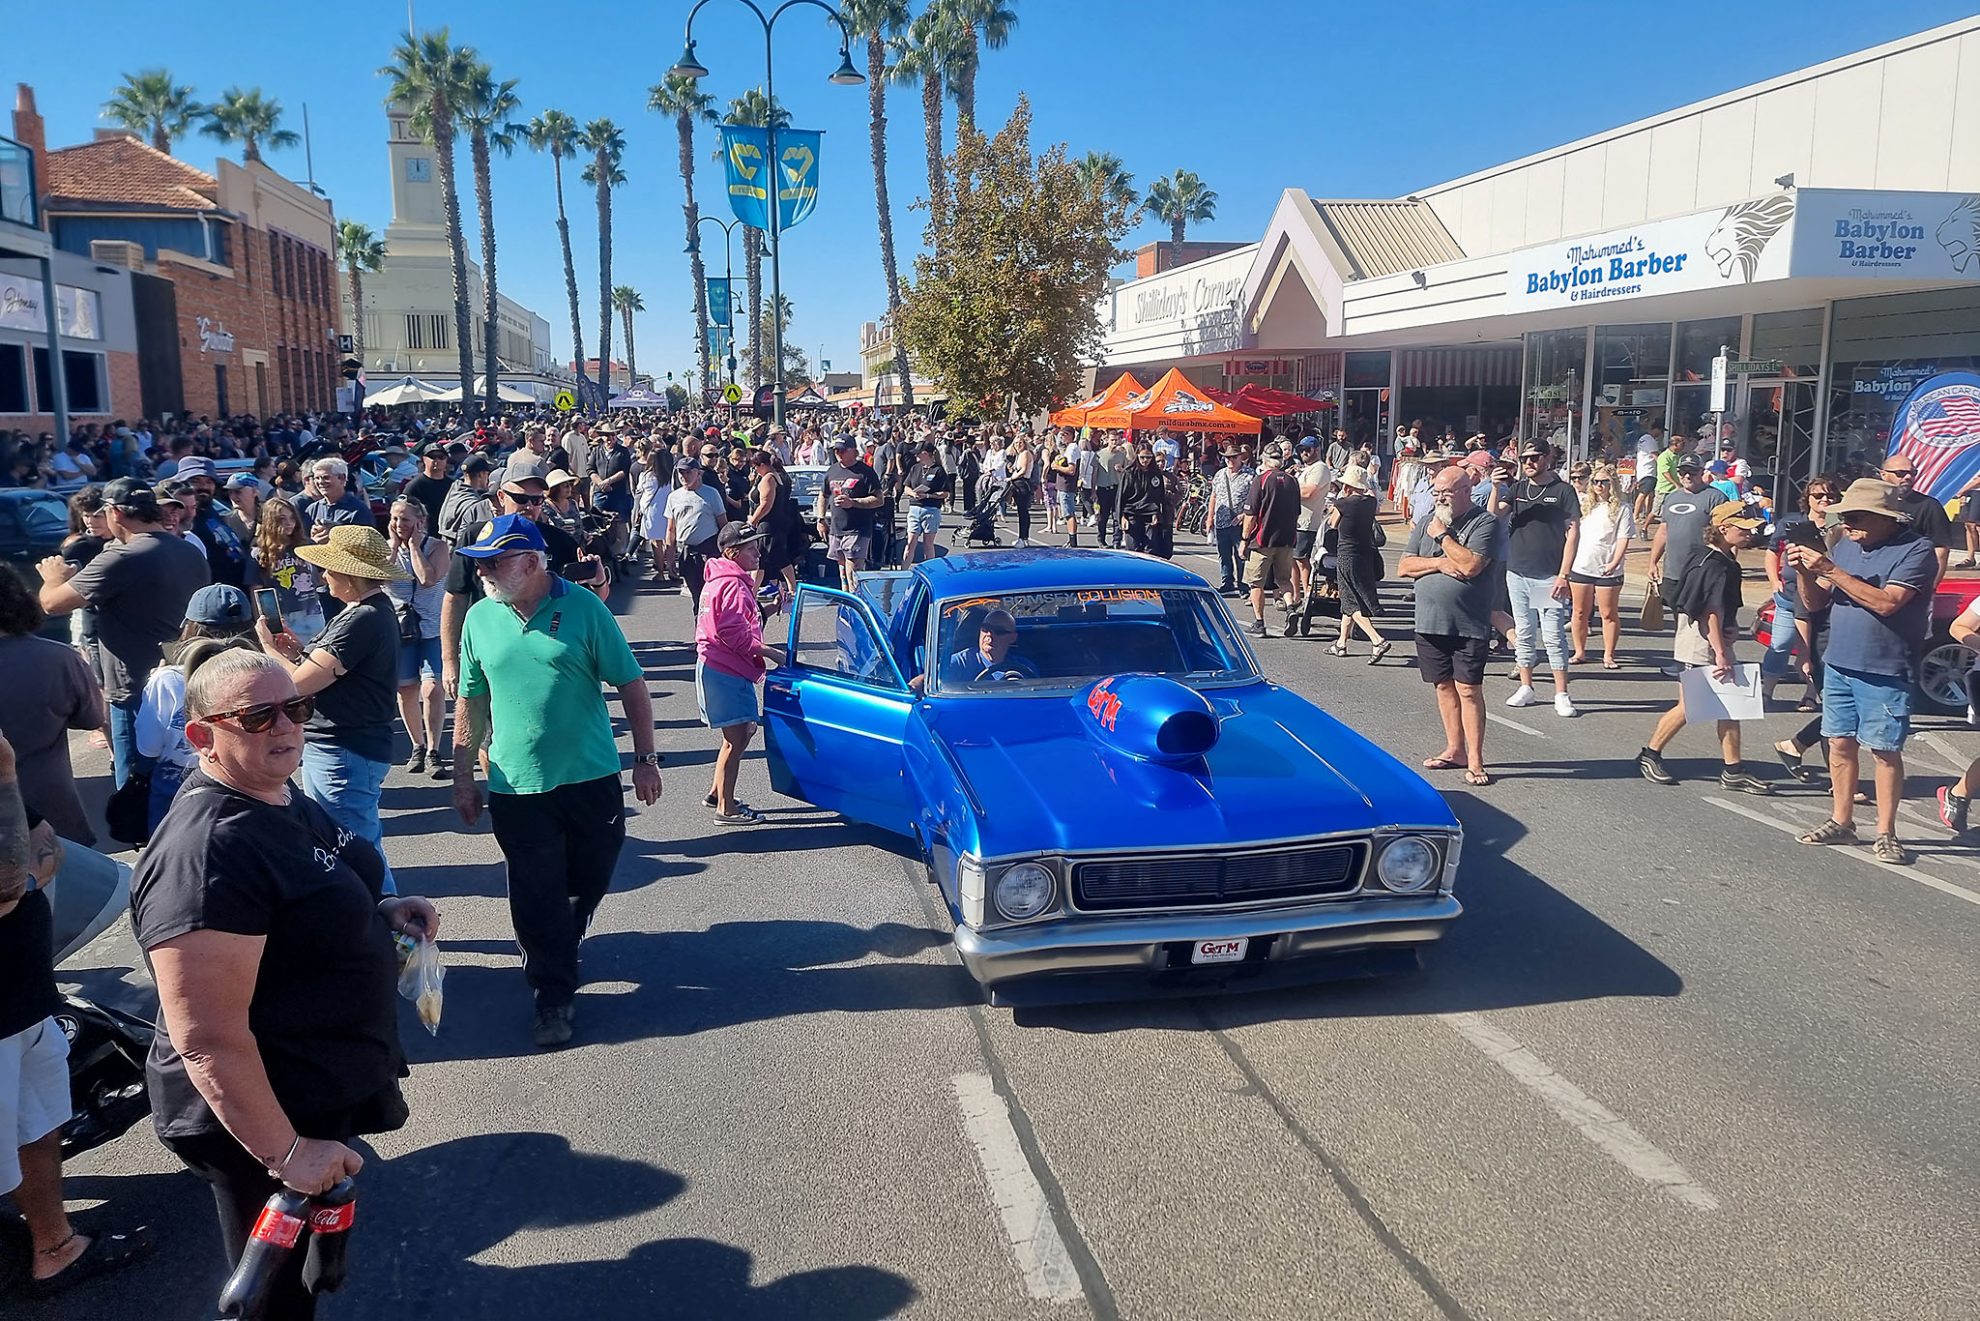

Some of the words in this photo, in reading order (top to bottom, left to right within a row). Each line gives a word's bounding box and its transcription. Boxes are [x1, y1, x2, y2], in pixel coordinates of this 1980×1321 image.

[1834, 219, 1925, 242] Babylon
[1839, 240, 1917, 260] Barber
[1526, 265, 1603, 294] Babylon
[1608, 251, 1688, 281] Barber
[1135, 285, 1188, 323] Shilliday's
[1194, 277, 1241, 312] Corner
[1570, 291, 1579, 301] &
[1580, 284, 1642, 300] Hairdressers
[1854, 379, 1912, 394] Babylon
[1951, 386, 1972, 396] CAR
[1158, 418, 1236, 429] mildurabmx.com.au
[1076, 589, 1163, 602] COLLISION
[1201, 942, 1239, 954] GTM
